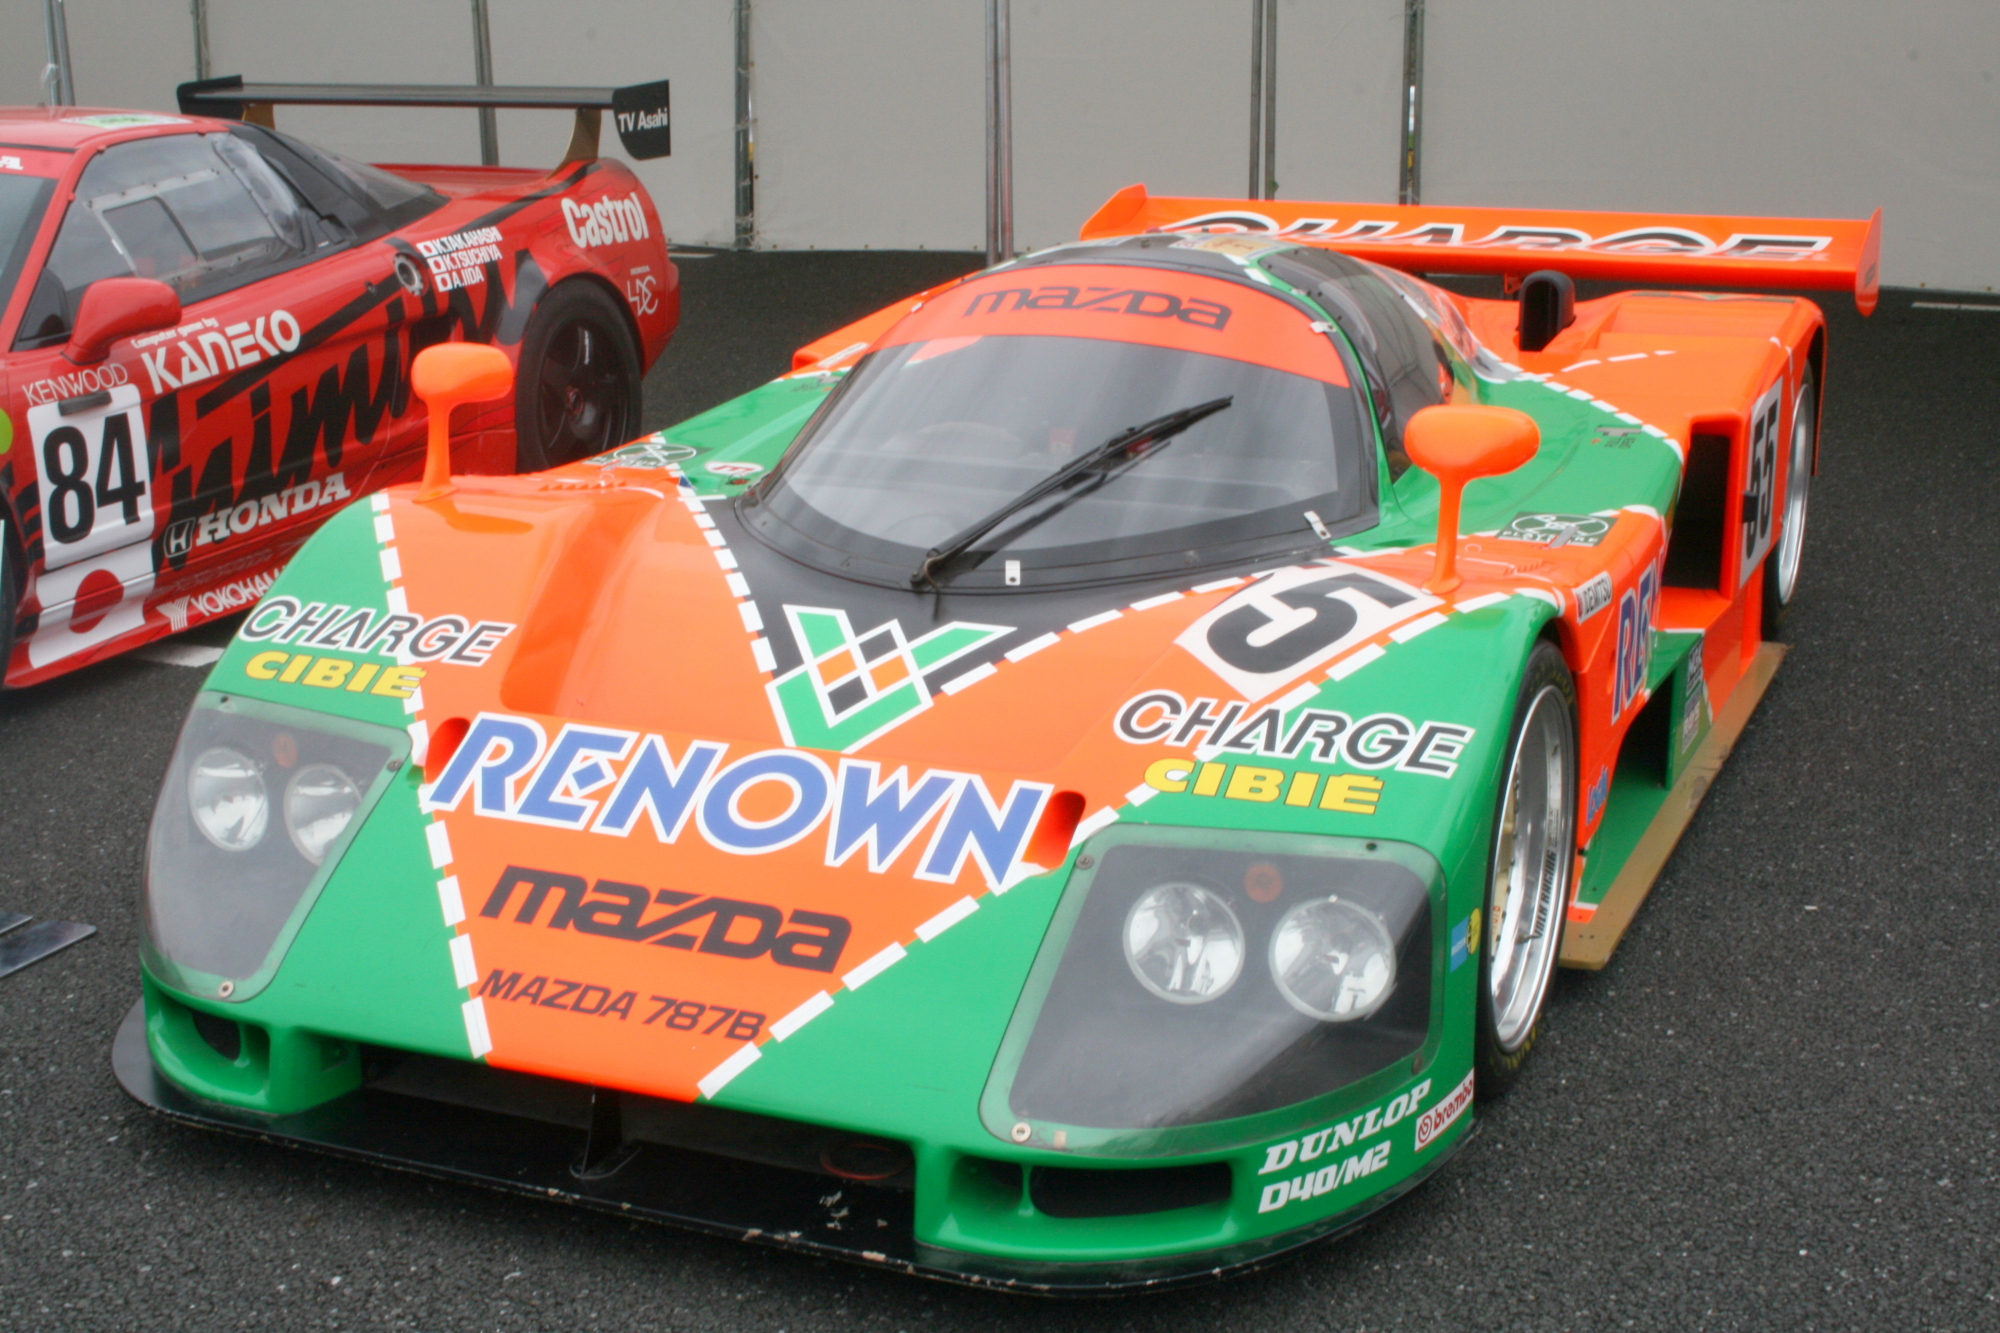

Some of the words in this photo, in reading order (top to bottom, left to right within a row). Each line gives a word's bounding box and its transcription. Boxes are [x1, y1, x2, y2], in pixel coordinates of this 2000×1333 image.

[618, 112, 635, 133] TV
[637, 107, 668, 130] Asahi
[562, 192, 649, 249] Castrol
[22, 362, 128, 406] KENWOOD
[141, 309, 301, 395] KANEKO
[43, 412, 146, 544] 84
[195, 472, 350, 546] HONDA
[190, 565, 286, 617] YOKOHA
[238, 595, 516, 667] CHARGE
[1113, 689, 1476, 779] CHARGE
[426, 711, 1054, 896] RENOWN
[477, 968, 639, 1021] MAZDA
[642, 995, 768, 1042] 787B
[1258, 1078, 1432, 1176] DUNLOP
[1433, 1078, 1474, 1131] brembo
[1258, 1140, 1391, 1214] D40/M2
